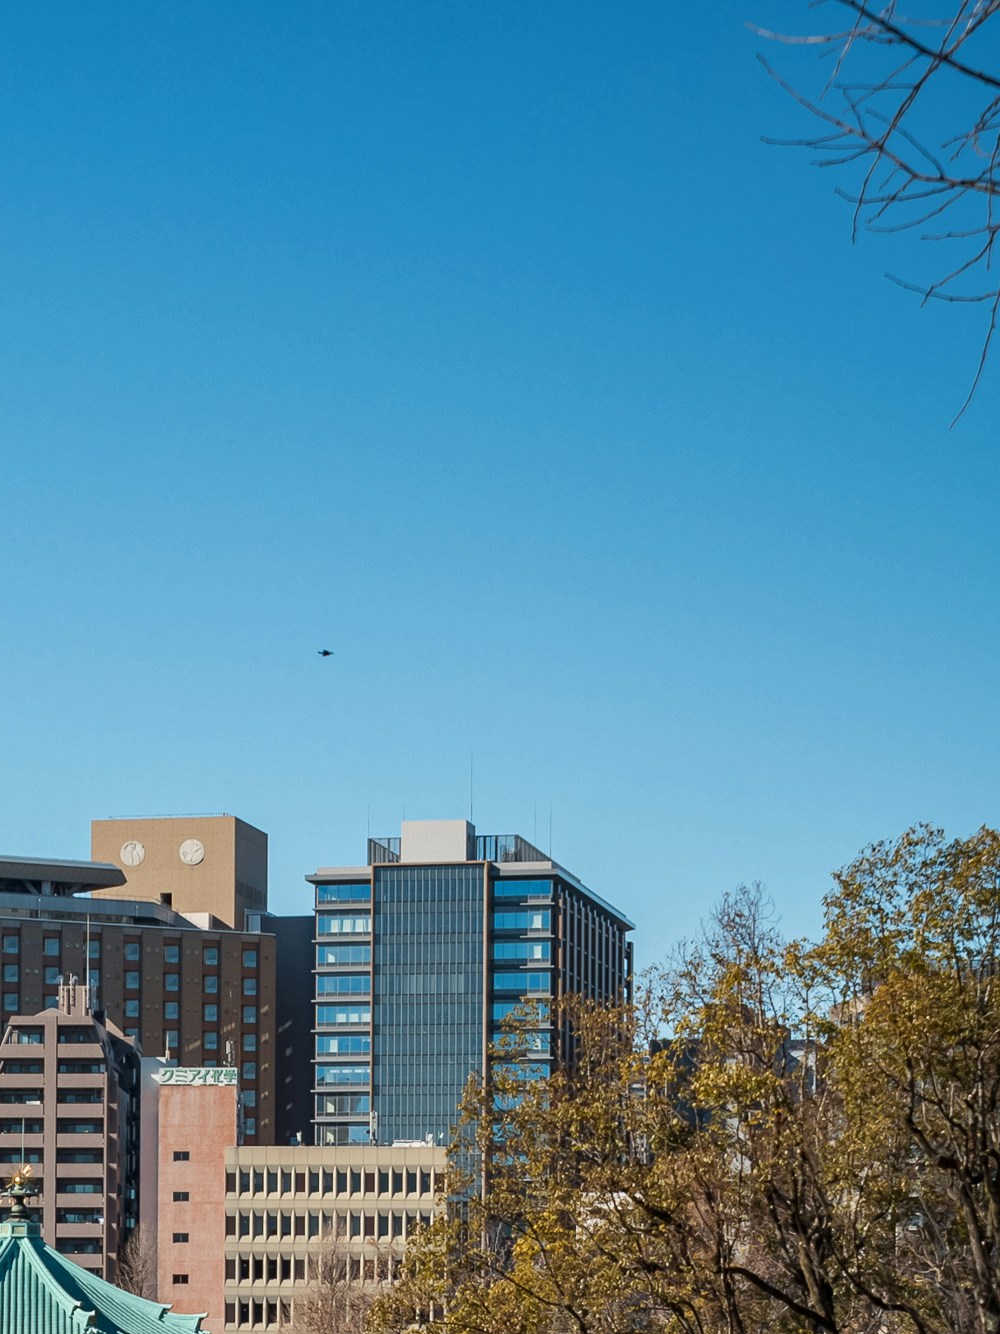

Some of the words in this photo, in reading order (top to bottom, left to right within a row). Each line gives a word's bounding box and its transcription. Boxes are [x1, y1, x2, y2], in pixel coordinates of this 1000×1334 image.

[161, 1069, 237, 1083] クミアイ化学
